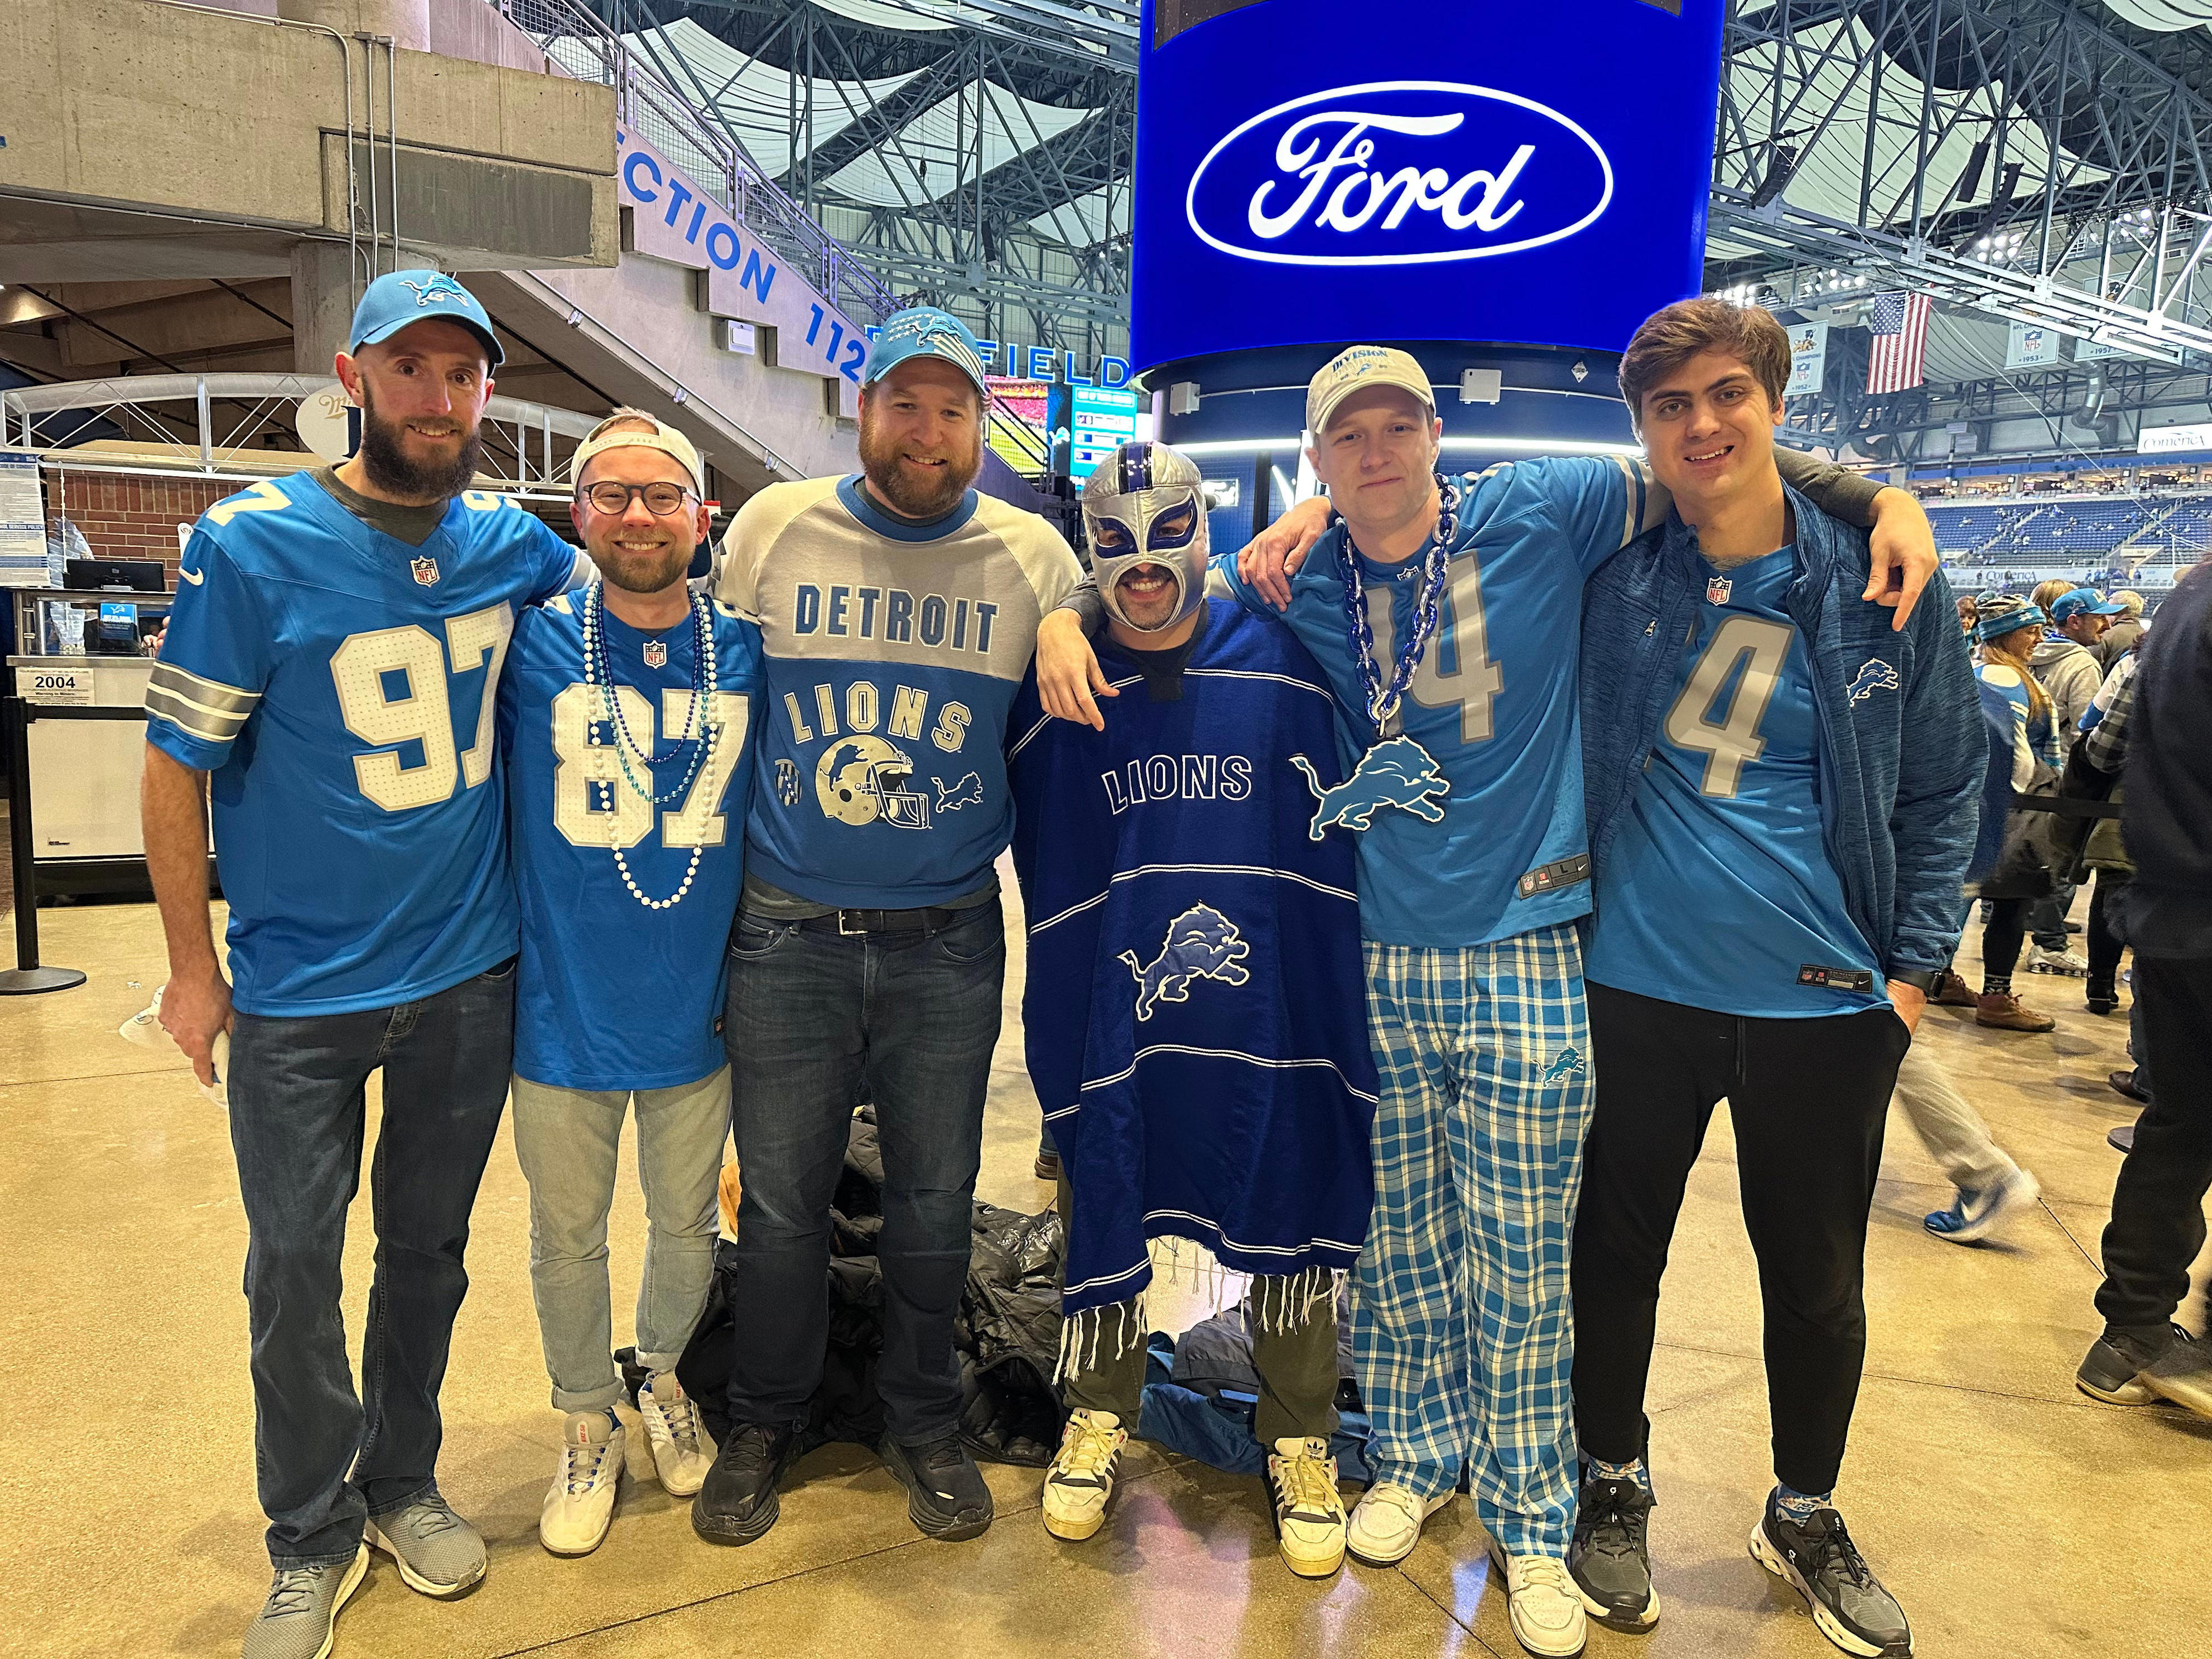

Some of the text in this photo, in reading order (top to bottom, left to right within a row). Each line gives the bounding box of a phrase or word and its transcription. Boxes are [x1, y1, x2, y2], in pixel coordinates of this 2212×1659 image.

[1249, 111, 1535, 238] Ford
[617, 129, 866, 383] CTION 112
[1332, 350, 1389, 373] DIVISION
[418, 569, 436, 581] NFL
[1709, 589, 1726, 601] NFL
[793, 582, 1000, 654] DETROIT
[35, 676, 75, 688] 2004
[648, 653, 663, 663] NFL
[329, 599, 514, 812] 97
[783, 681, 972, 753] LIONS
[1651, 615, 1796, 799] 4
[551, 682, 751, 848] 87
[1101, 754, 1252, 815] LIONS
